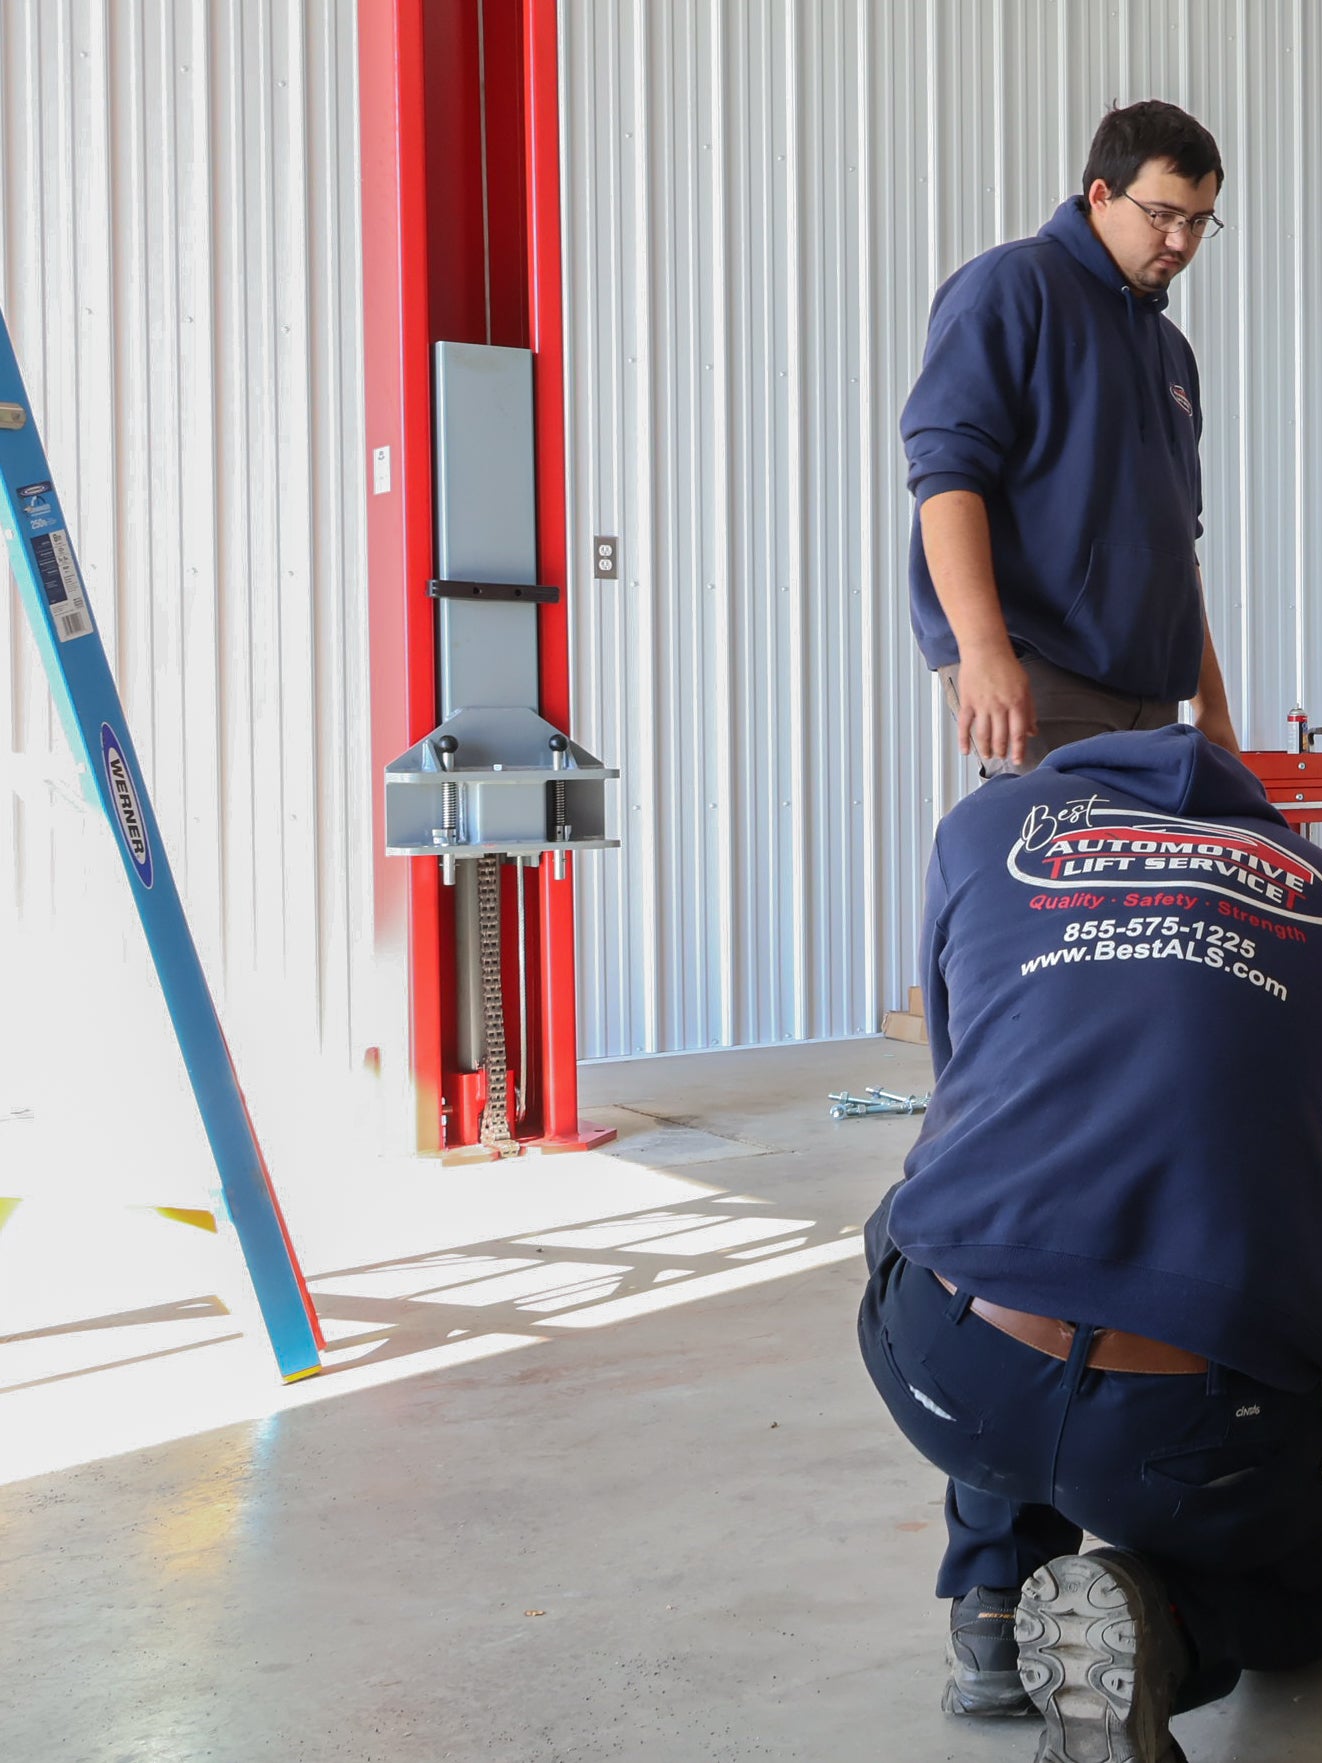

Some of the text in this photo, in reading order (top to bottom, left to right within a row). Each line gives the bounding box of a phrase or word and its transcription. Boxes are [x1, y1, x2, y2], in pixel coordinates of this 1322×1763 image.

[110, 758, 145, 854] WERNER
[1022, 794, 1110, 853] Best
[1044, 839, 1305, 893] AUTOMOTIVE
[1144, 856, 1284, 905] SERVICE
[1029, 892, 1308, 944] Quality Safety Strength
[1063, 916, 1257, 960] 855-575-1225
[1020, 938, 1289, 1002] www.BestALS.com
